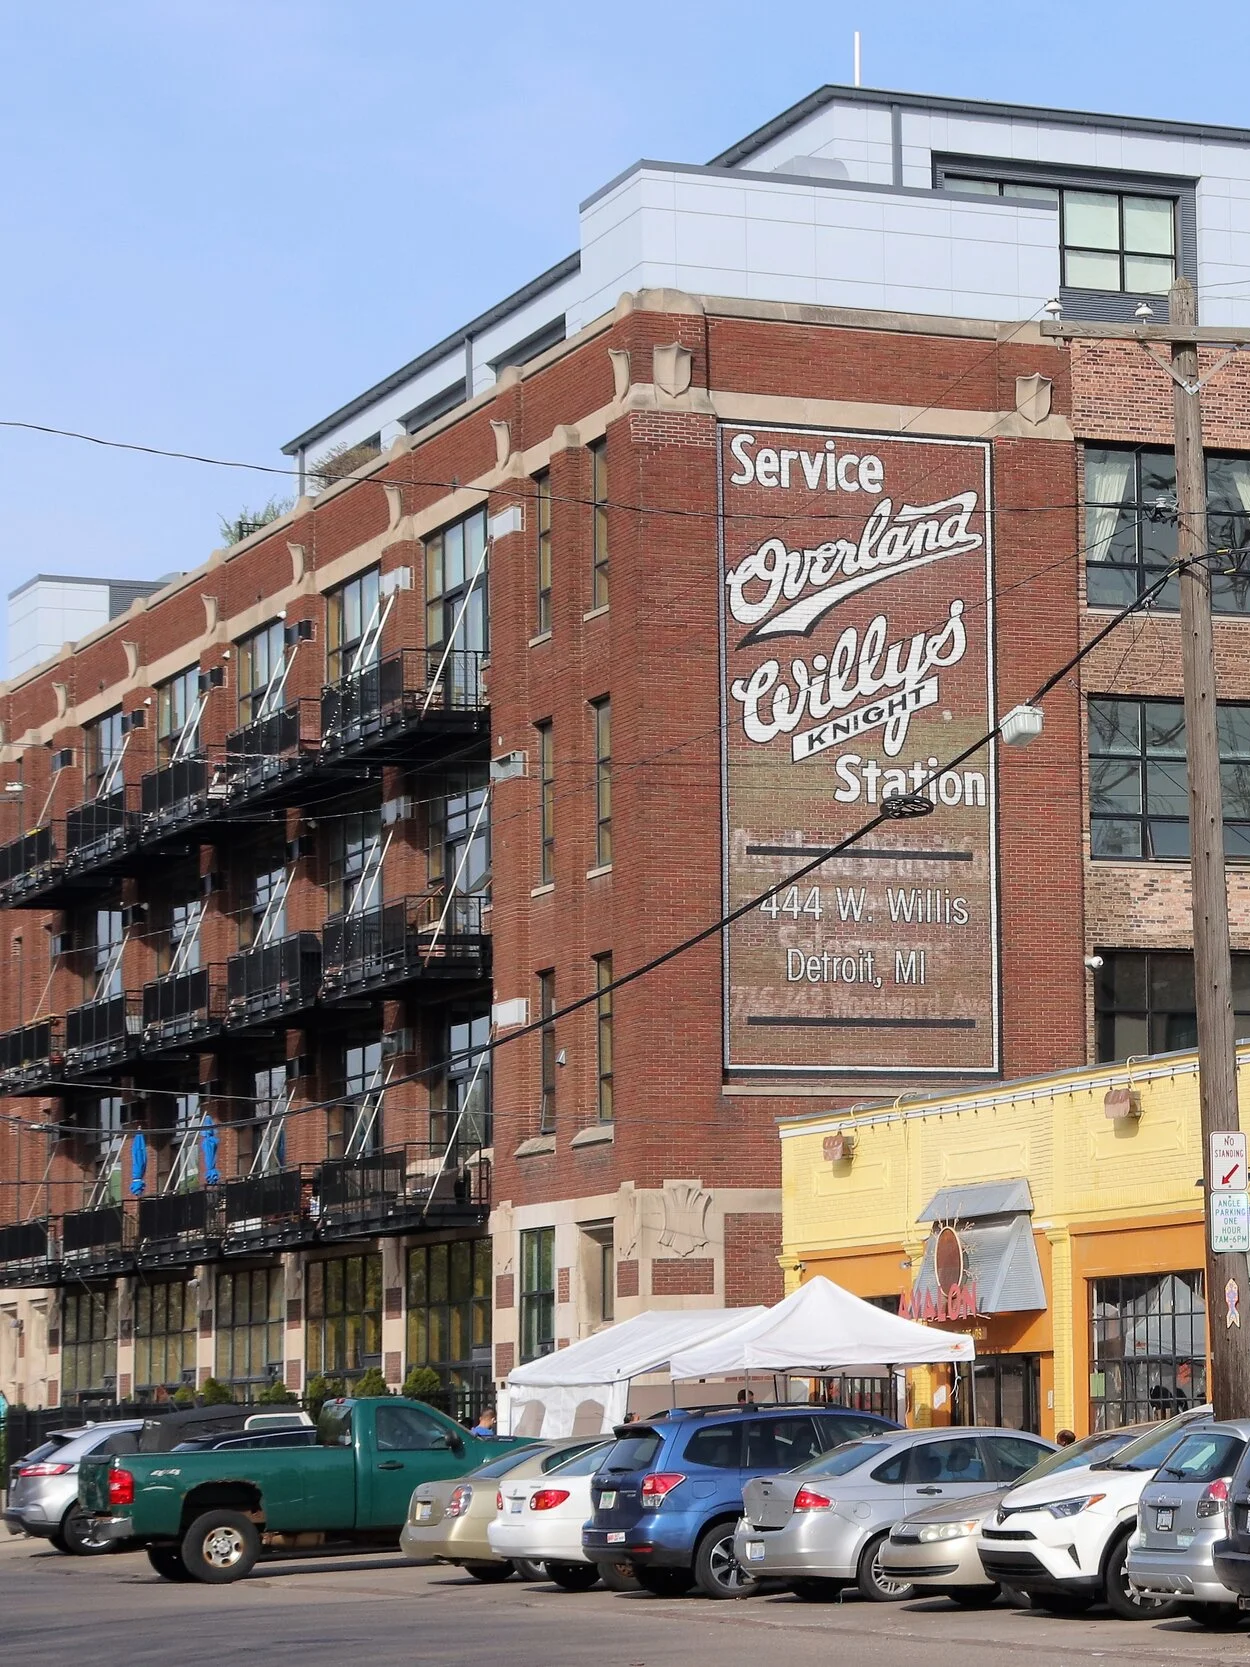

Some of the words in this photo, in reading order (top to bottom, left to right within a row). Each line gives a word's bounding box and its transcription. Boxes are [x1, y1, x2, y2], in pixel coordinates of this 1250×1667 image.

[730, 433, 884, 493] Service
[725, 490, 983, 626] Overland
[730, 599, 967, 756] Willys
[807, 685, 926, 752] KNIGHT
[834, 754, 987, 807] Station
[760, 885, 822, 921] 444
[835, 887, 873, 923] W.
[887, 888, 970, 926] Willis
[786, 948, 882, 988] Detroit,
[894, 951, 926, 985] MI
[1215, 1149, 1244, 1158] STANDING
[1224, 1137, 1234, 1146] NO
[1215, 1235, 1247, 1244] 7AM-6PM
[1222, 1226, 1241, 1234] HOUR
[1224, 1217, 1238, 1225] ONE
[898, 1282, 977, 1322] AVALON
